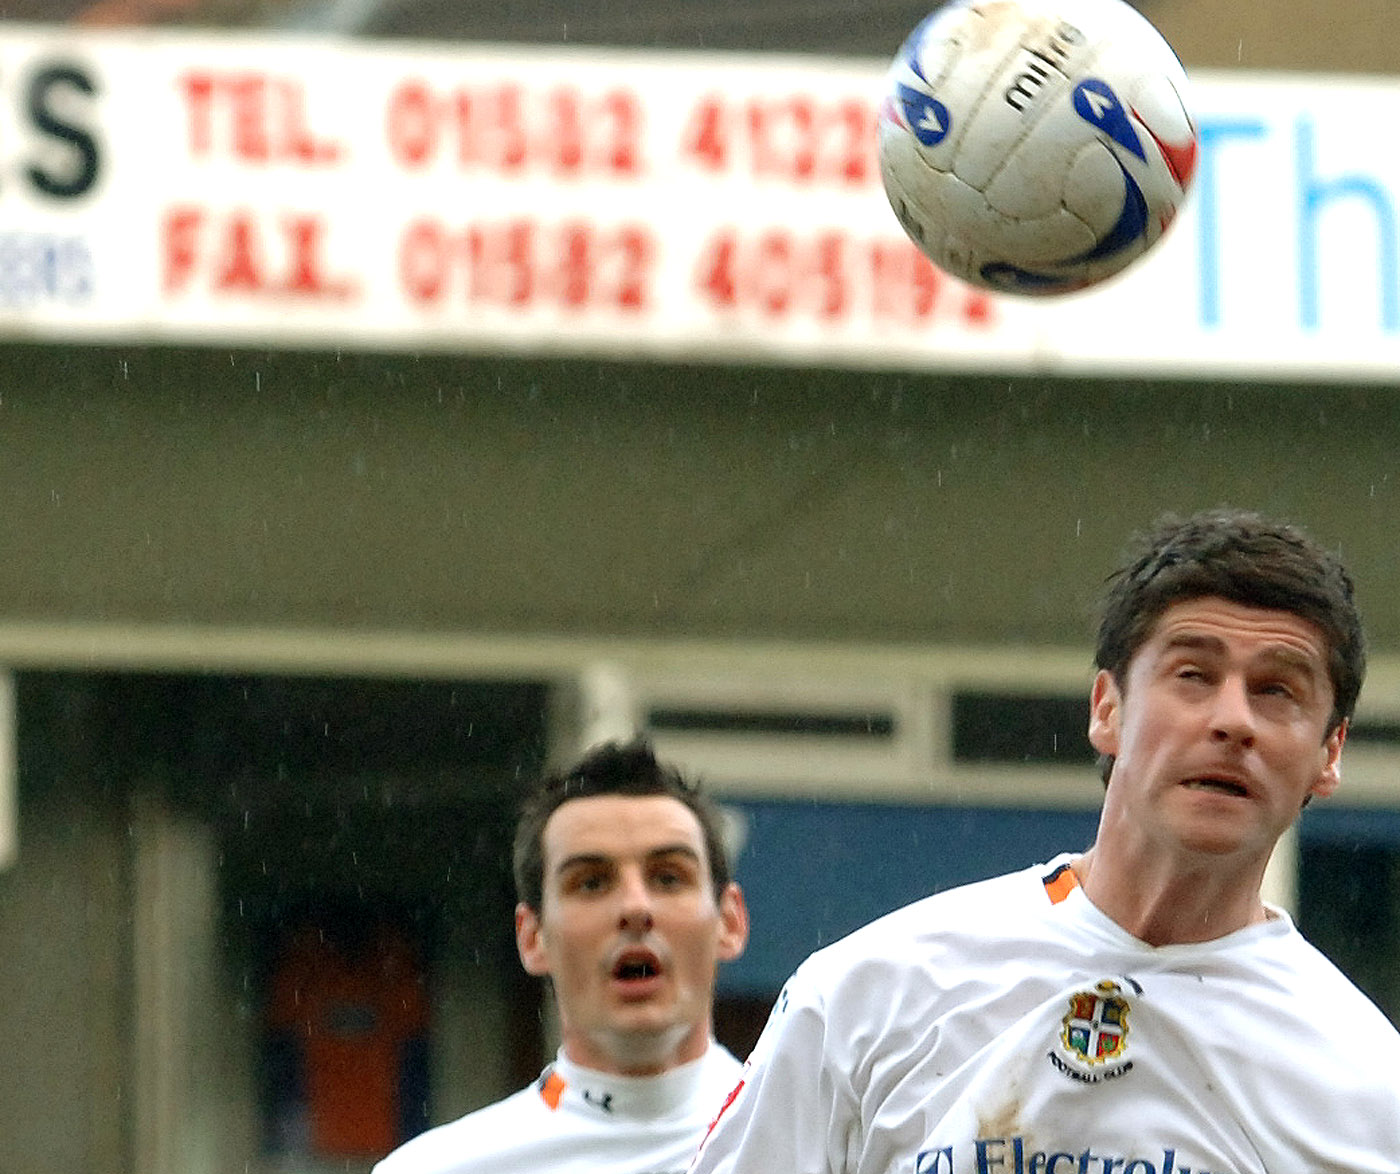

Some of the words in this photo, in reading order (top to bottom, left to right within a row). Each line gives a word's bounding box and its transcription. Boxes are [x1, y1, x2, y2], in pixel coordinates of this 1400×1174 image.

[1003, 19, 1087, 112] mitre
[18, 58, 104, 206] S
[680, 92, 886, 190] 4122
[694, 228, 994, 328] 40519
